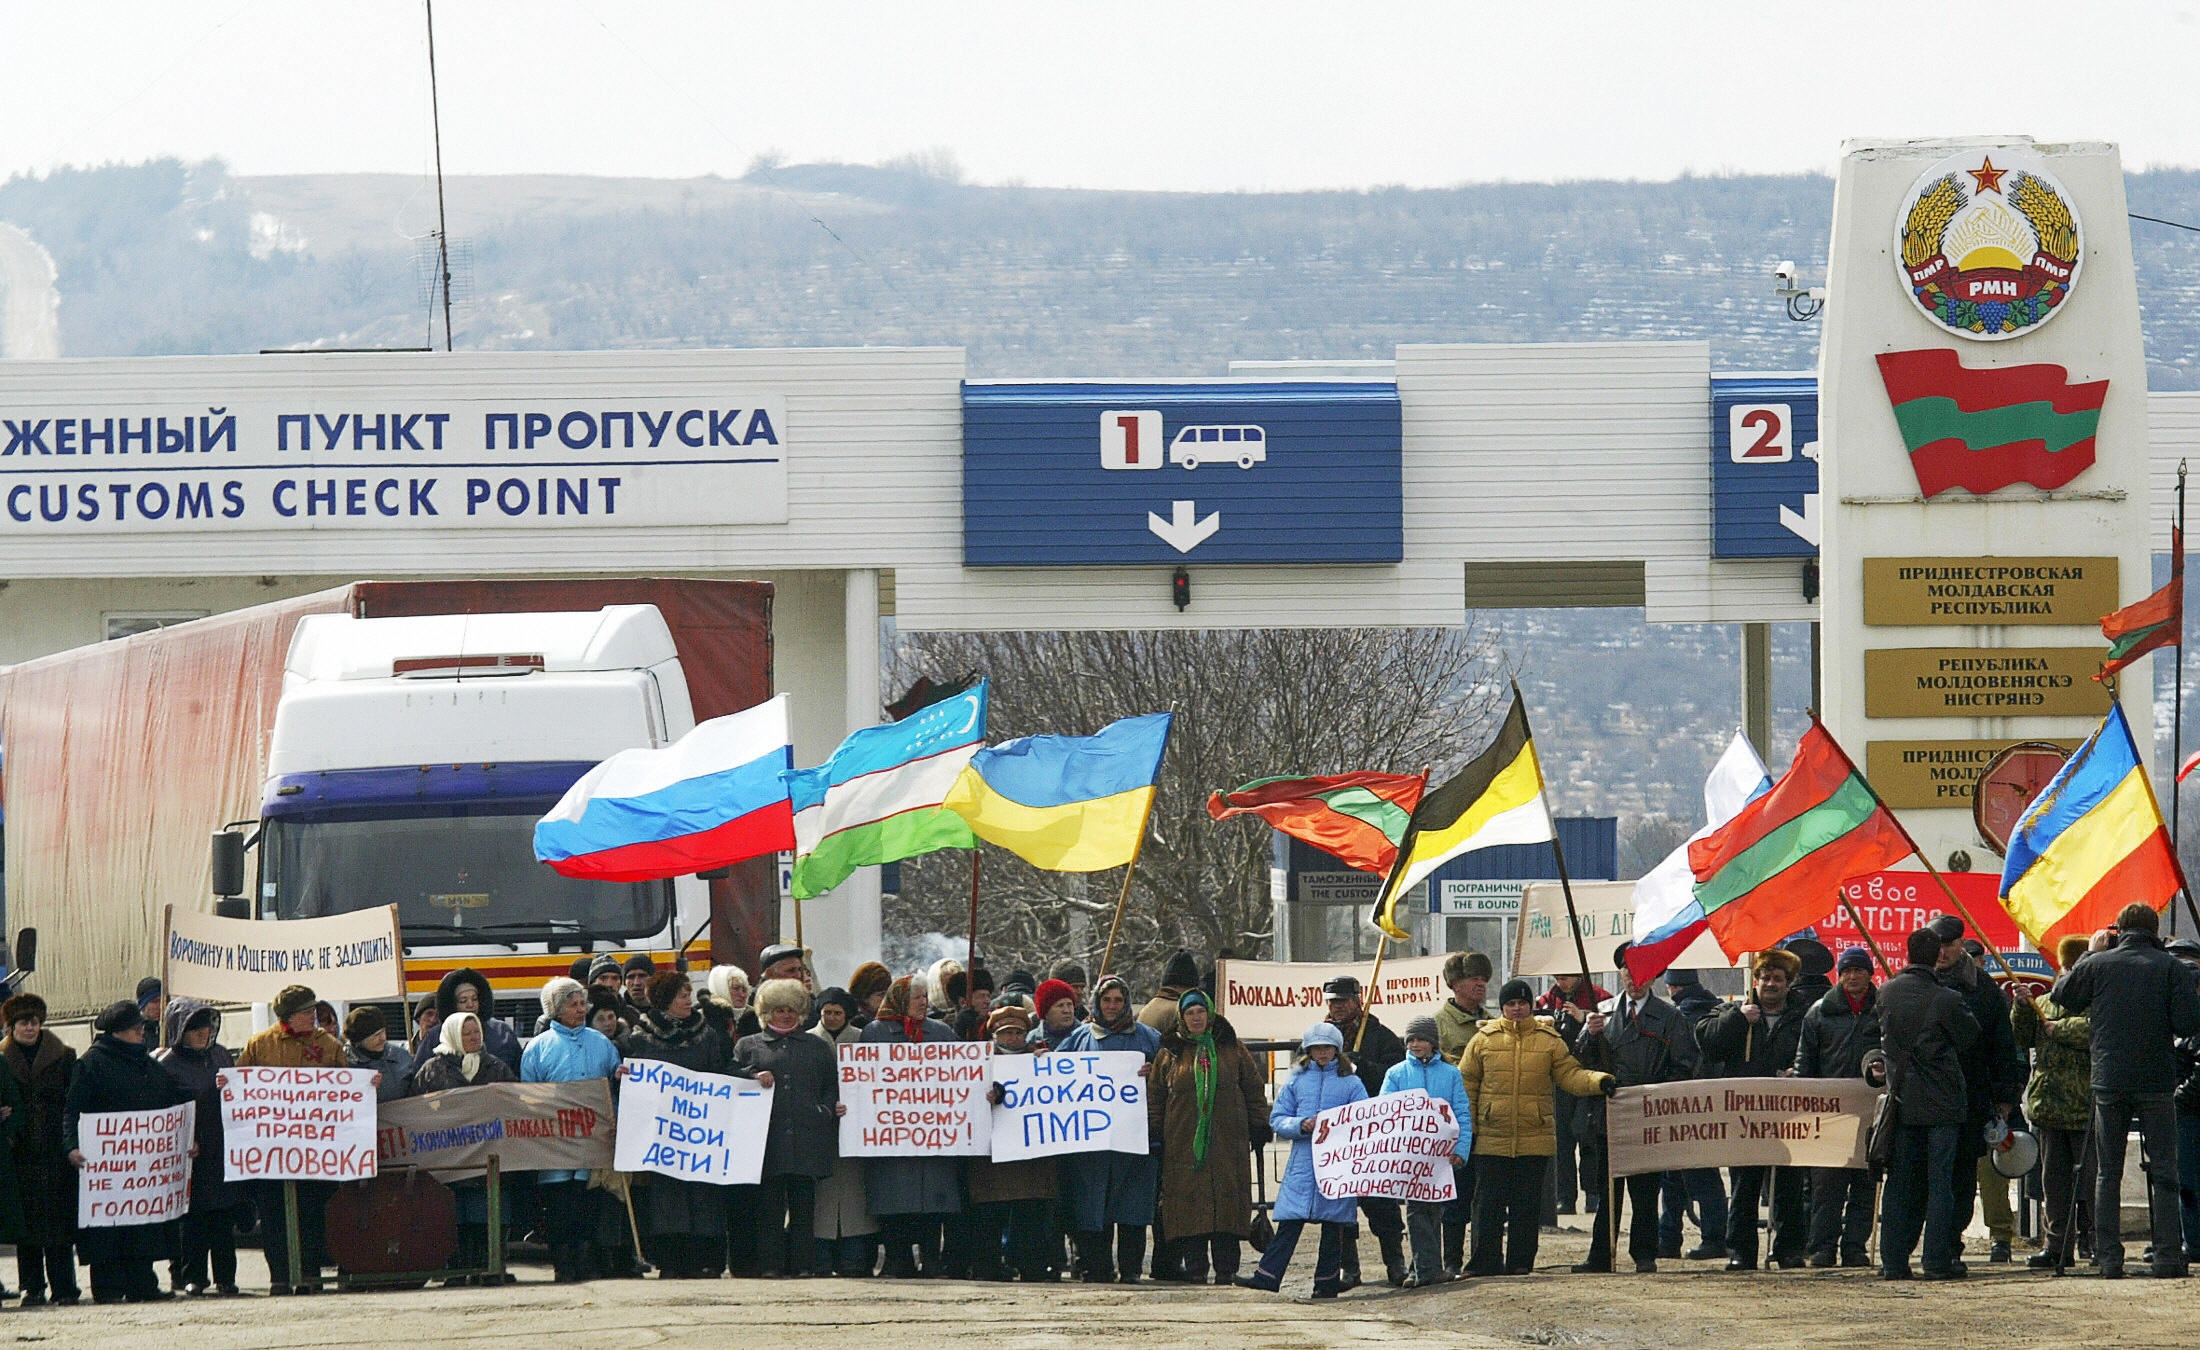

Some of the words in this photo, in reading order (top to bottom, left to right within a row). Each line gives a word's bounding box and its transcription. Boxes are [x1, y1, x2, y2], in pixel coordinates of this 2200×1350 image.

[1913, 259, 1945, 281] ПМР
[1969, 281, 2017, 296] РМН
[2035, 256, 2069, 277] ПМР
[1, 407, 238, 456] ЖЕННЫЙ
[277, 412, 450, 452] ПУНКТ
[485, 408, 780, 449] ПРОПУСКА
[1117, 416, 1139, 464] 1
[1740, 409, 1783, 458] 2
[7, 479, 246, 523] CUSTOMS
[272, 477, 441, 518] CHECK
[466, 476, 622, 517] POINT
[1899, 567, 2083, 581] ПРИДНЕСТРОВСКАЯ
[1927, 584, 2055, 597] МОЛДАВСКАЯ
[1930, 601, 2052, 615] РЕСПУБЛИКА
[1938, 658, 2049, 671] РЕПУБЛИКА
[1916, 675, 2073, 690] МОЛДОВЕНЯСКЭ
[1944, 692, 2045, 706] НИСТРЯНЭ
[1902, 749, 2000, 763] ПРИДНІСТ
[1303, 874, 1381, 883] ТАМОЖЕННЫ
[1311, 889, 1330, 898] THE
[1453, 900, 1472, 909] THE
[1477, 900, 1520, 909] BOUND
[226, 947, 233, 970] И
[237, 944, 288, 973] ЮЩЕНКО
[293, 948, 314, 971] НАС
[319, 946, 331, 969] НЕ
[335, 931, 393, 967] ЗАДУШИТЬ!
[1386, 976, 1431, 990] ПРОТИВ
[1387, 991, 1431, 1004] НАРОДА
[236, 1068, 353, 1085] ТОЛЬКО
[841, 1066, 876, 1082] ВЫ
[881, 1065, 984, 1083] ЗАКРЫЛИ
[223, 1088, 234, 1102] В
[872, 1087, 970, 1108] ГРАНИЦУ
[231, 1106, 354, 1122] НАРУШАЛИ
[672, 1095, 709, 1120] МЫ
[505, 1118, 556, 1138] БЛОКАДЕ
[557, 1107, 597, 1138] ПМР
[1023, 1109, 1112, 1147] ПМР
[256, 1123, 336, 1141] ПРАВА
[655, 1116, 725, 1147] ТВОИ
[1643, 1126, 1662, 1145] НЕ
[1669, 1121, 1729, 1143] КРАСИТ
[101, 1132, 179, 1156] ПАНОВЕ!
[86, 1160, 138, 1173] НАШИ
[149, 1153, 182, 1172] ДЕТИ
[88, 1178, 112, 1191] НЕ
